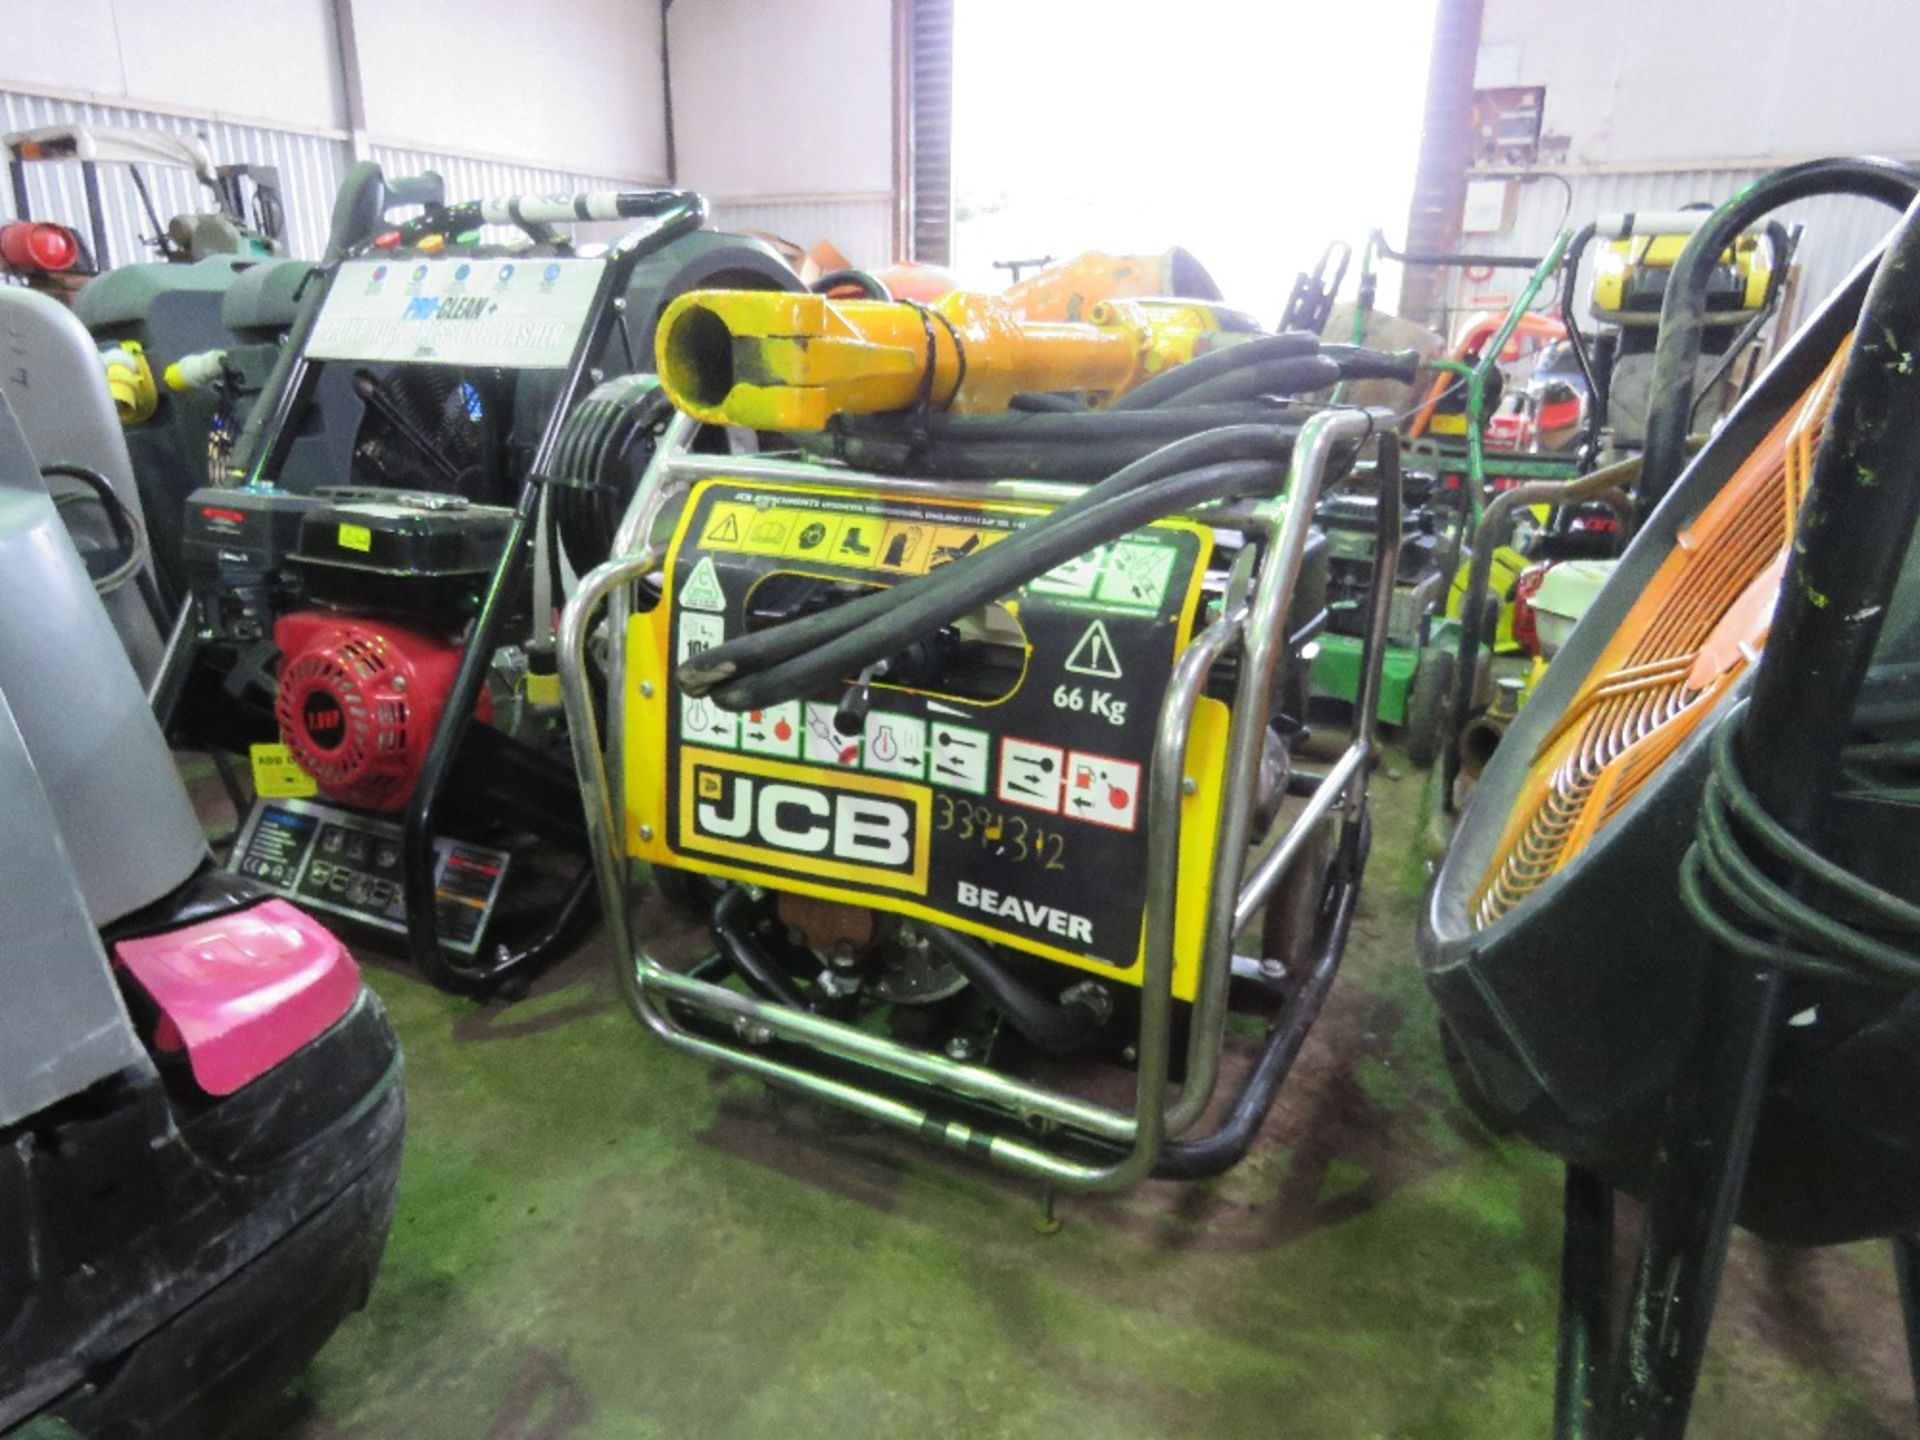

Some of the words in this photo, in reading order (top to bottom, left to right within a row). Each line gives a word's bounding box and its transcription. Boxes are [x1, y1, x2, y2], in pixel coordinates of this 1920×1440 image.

[492, 321, 565, 348] WASHER
[1053, 685, 1084, 711] 66
[1090, 689, 1128, 725] Kg
[698, 777, 910, 865] JCB
[958, 881, 1093, 944] BEAVER
